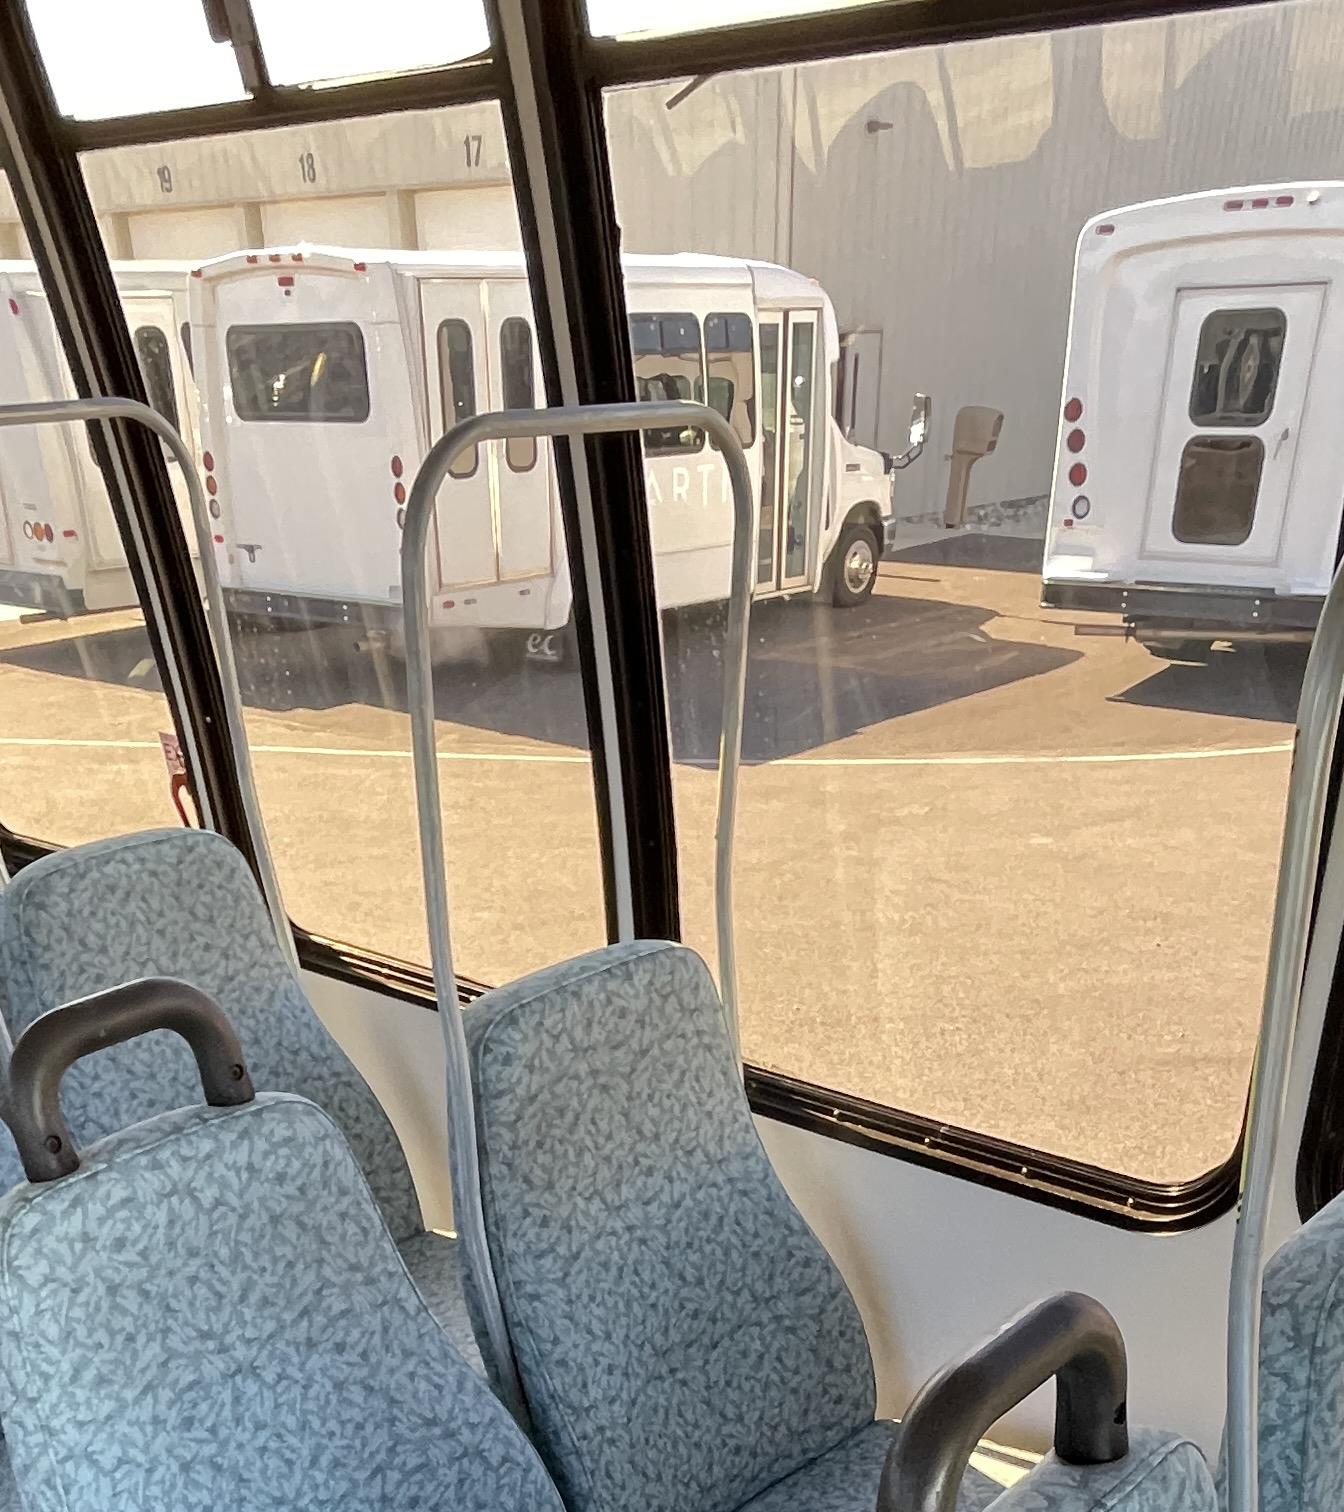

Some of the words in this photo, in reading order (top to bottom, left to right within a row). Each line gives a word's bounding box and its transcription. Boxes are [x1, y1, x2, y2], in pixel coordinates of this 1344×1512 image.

[464, 134, 482, 168] 17
[157, 165, 173, 193] 19
[299, 152, 316, 184] 18
